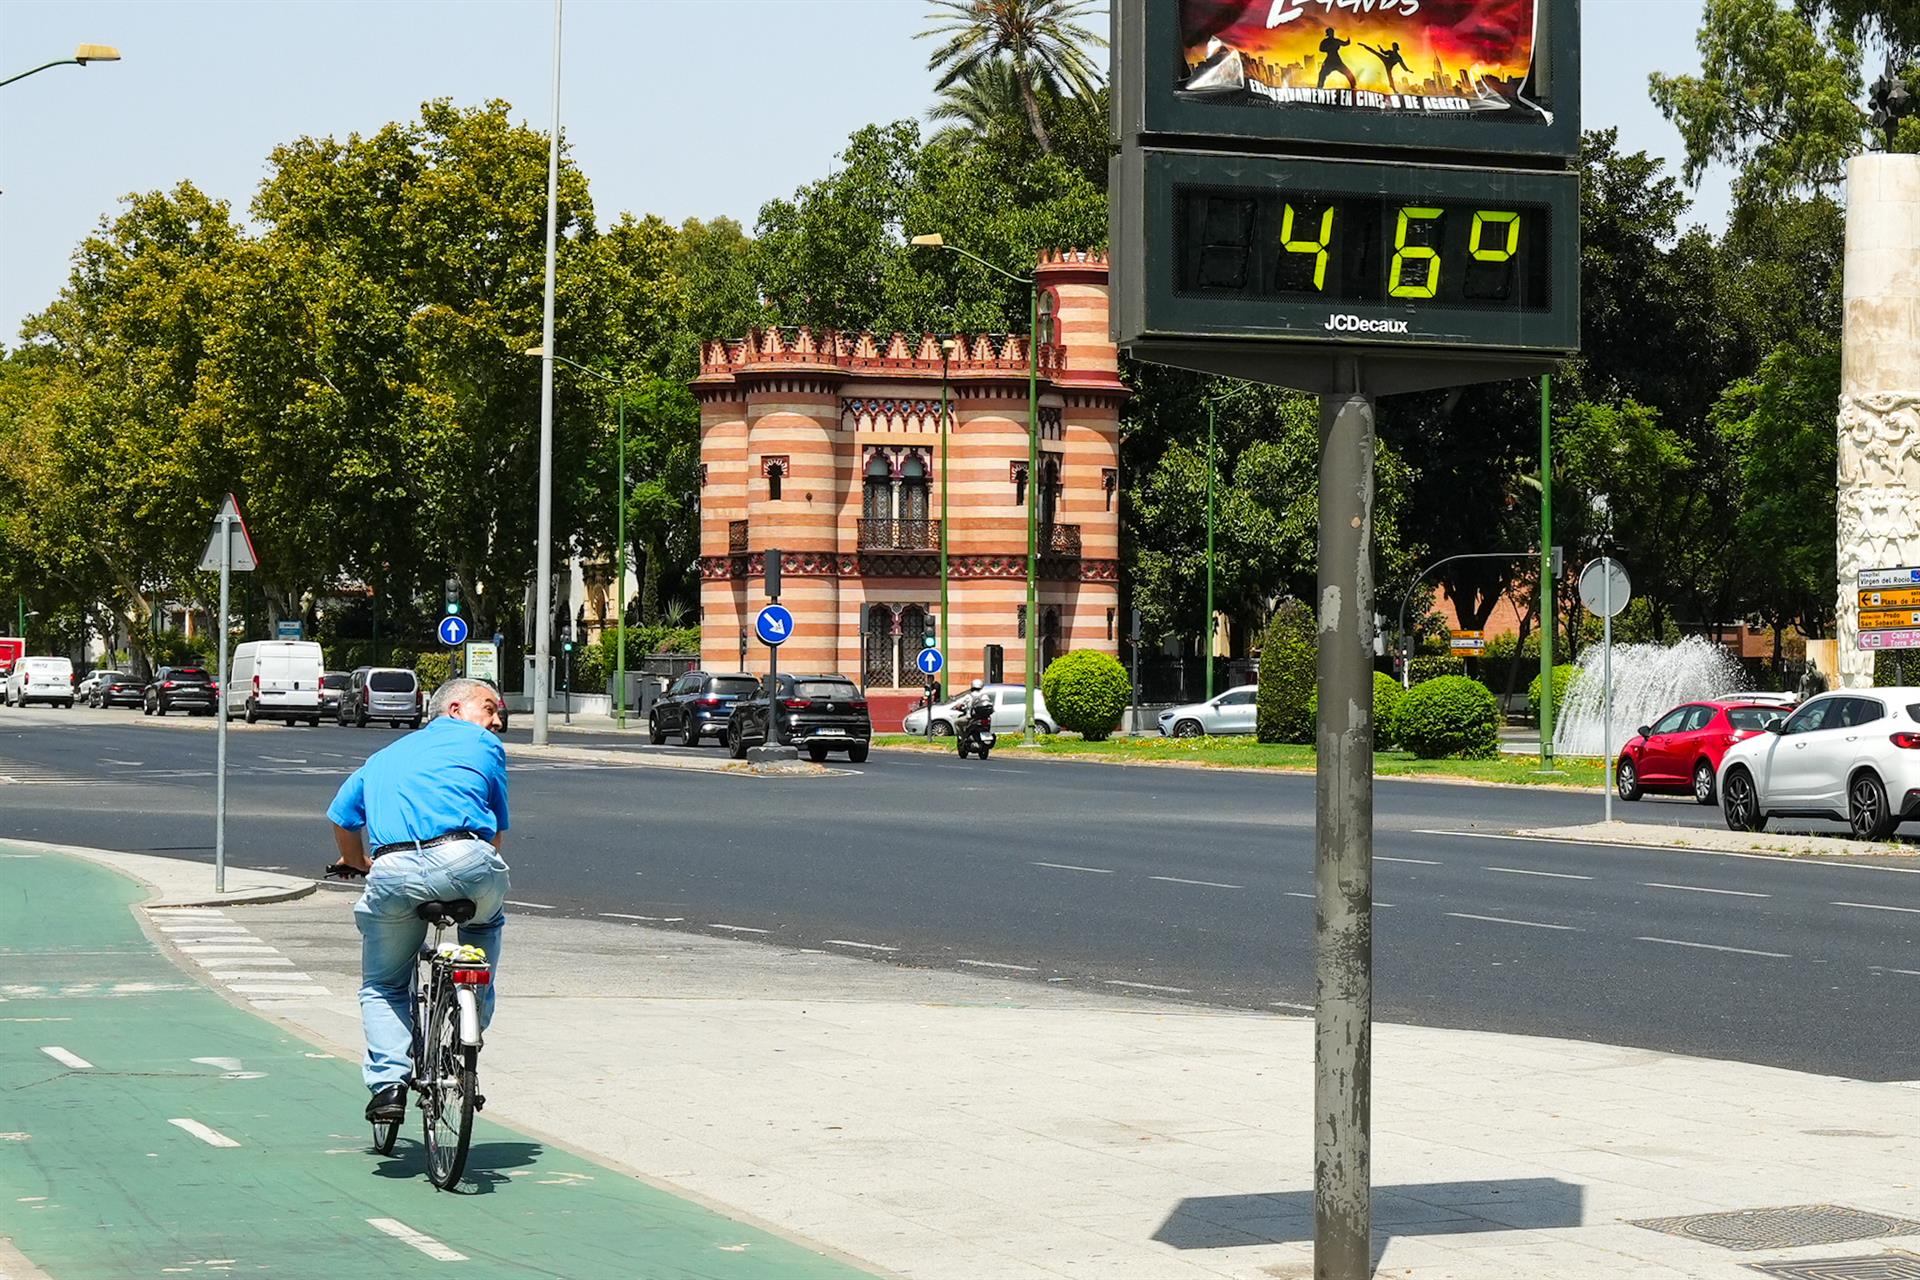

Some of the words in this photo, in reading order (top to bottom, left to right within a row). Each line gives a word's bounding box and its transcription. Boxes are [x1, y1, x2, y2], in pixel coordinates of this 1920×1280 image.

[1266, 0, 1420, 29] LNDS
[1341, 89, 1352, 106] EN
[1356, 90, 1385, 109] CINES
[1404, 95, 1420, 109] DE
[1422, 96, 1470, 110] AGOSTO
[1324, 314, 1408, 333] JCDecaux
[1860, 578, 1880, 586] Virgen
